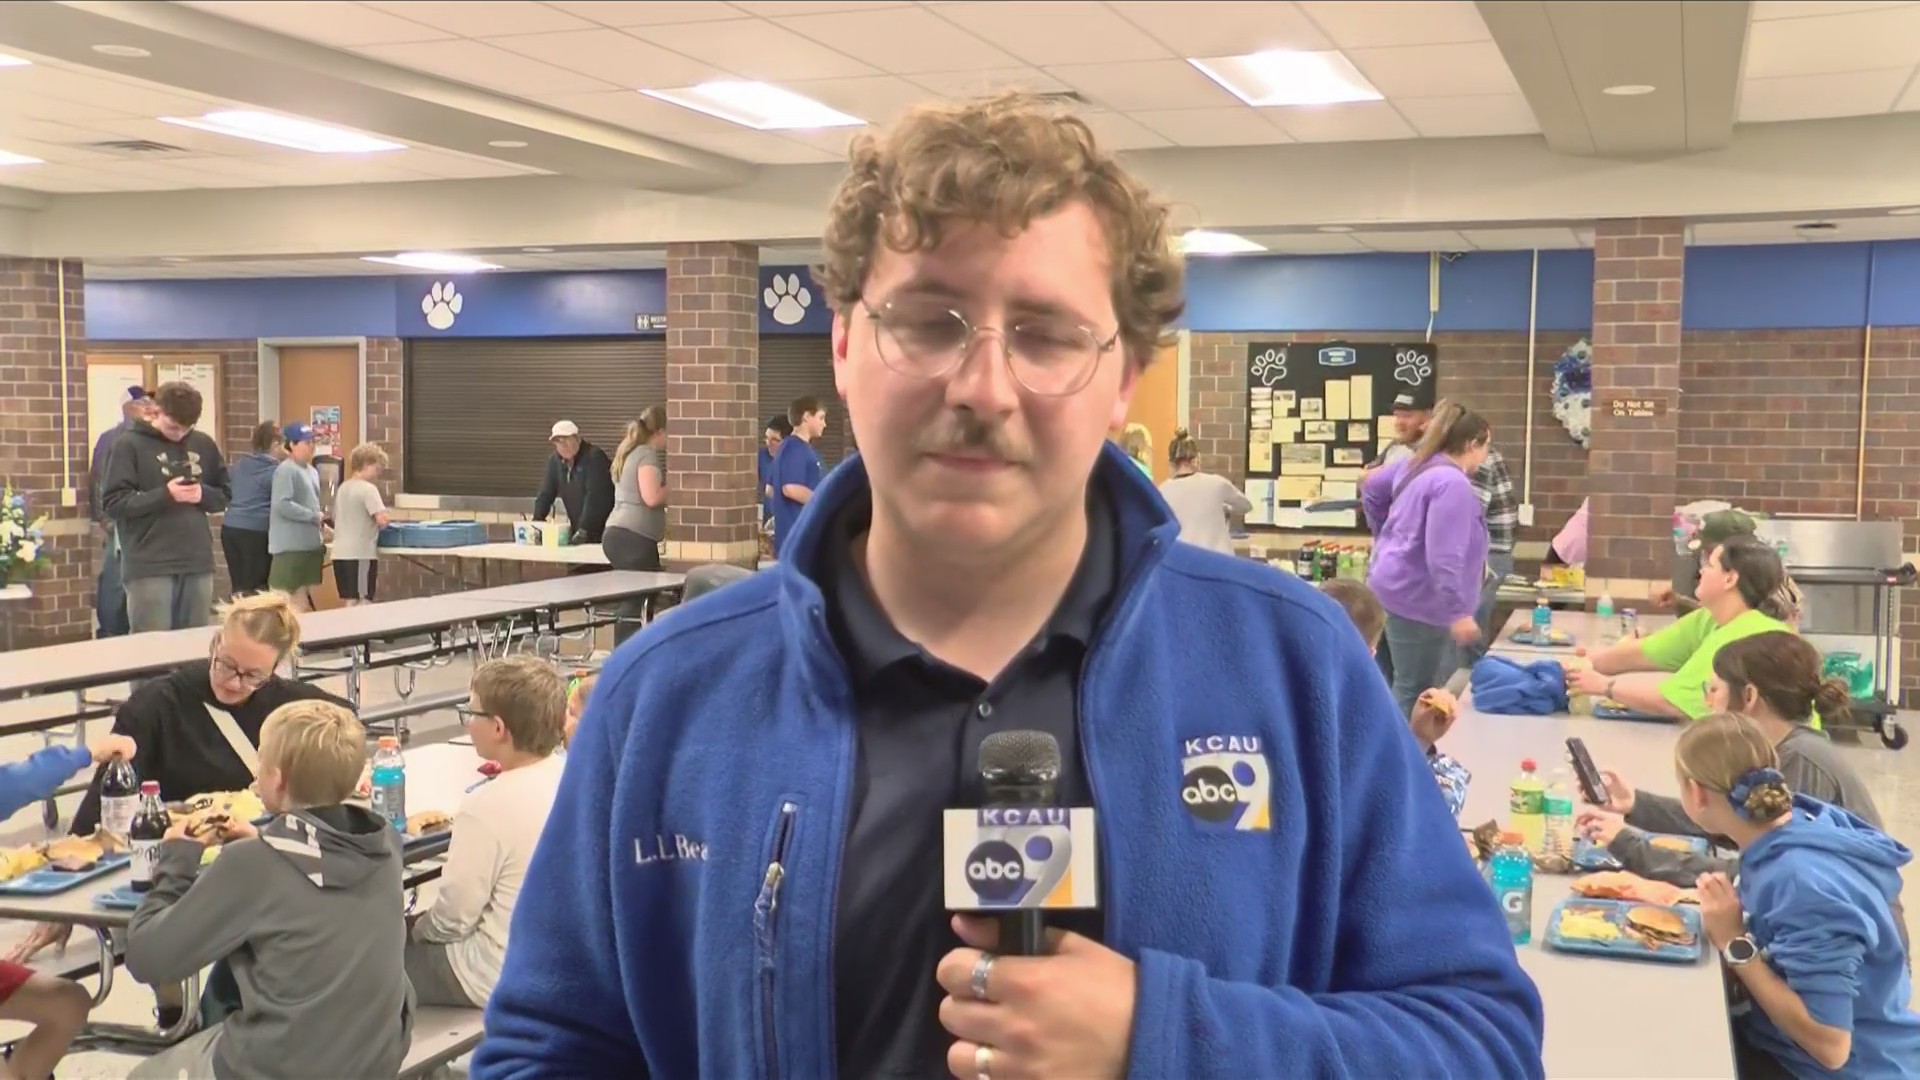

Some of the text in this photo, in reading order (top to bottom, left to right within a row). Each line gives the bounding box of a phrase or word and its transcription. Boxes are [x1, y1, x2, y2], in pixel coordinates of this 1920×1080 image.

[1613, 399, 1655, 408] Do Not Sit
[1613, 408, 1655, 417] On Tables
[1185, 735, 1258, 755] KCAU
[1182, 778, 1236, 804] abc
[982, 808, 1064, 824] KCAU
[968, 857, 1021, 880] abc
[1502, 891, 1523, 913] G
